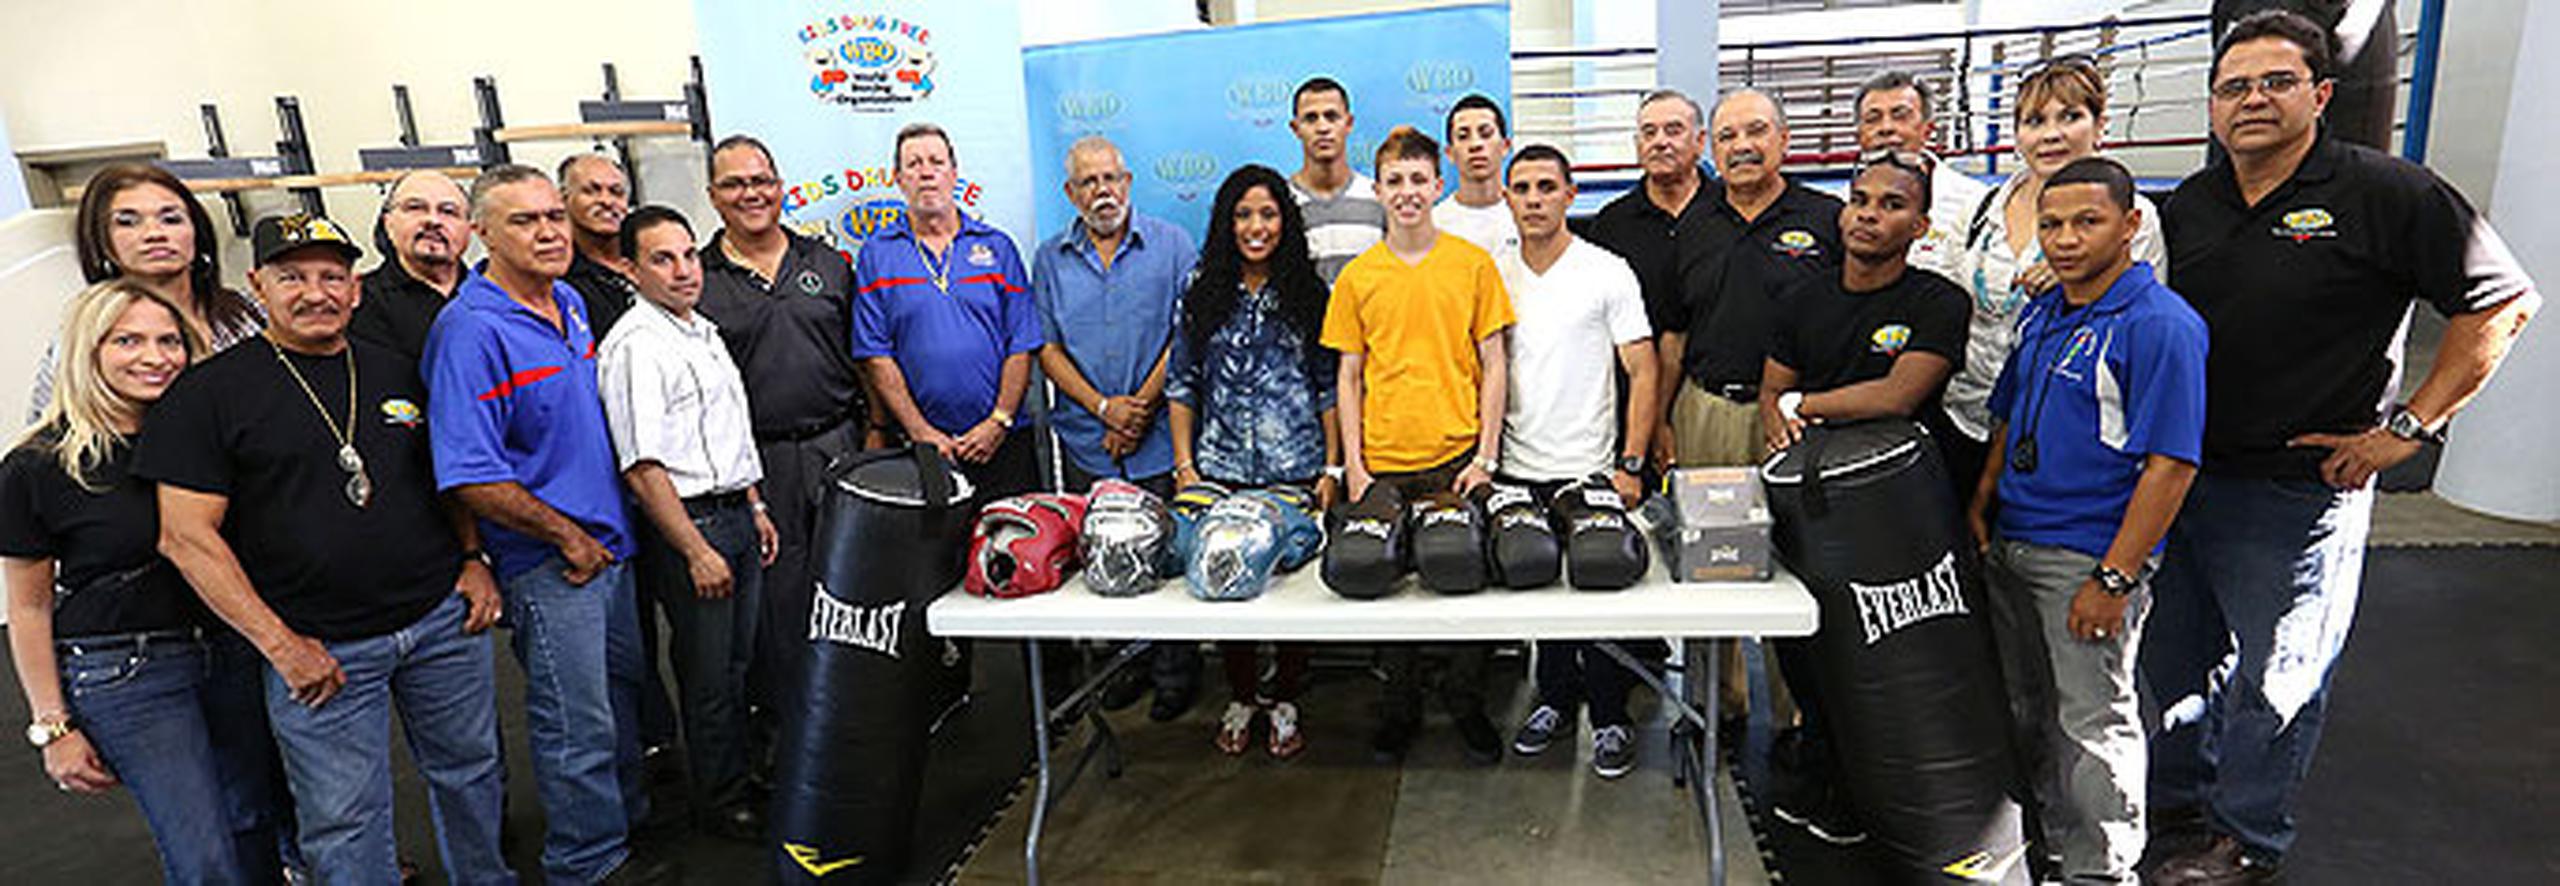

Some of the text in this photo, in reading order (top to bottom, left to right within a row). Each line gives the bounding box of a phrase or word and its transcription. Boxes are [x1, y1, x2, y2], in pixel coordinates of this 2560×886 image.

[845, 40, 895, 61] WBO
[844, 167, 898, 191] DRU
[808, 581, 906, 659] EVERLAST
[1849, 550, 1971, 646] EVERLAST
